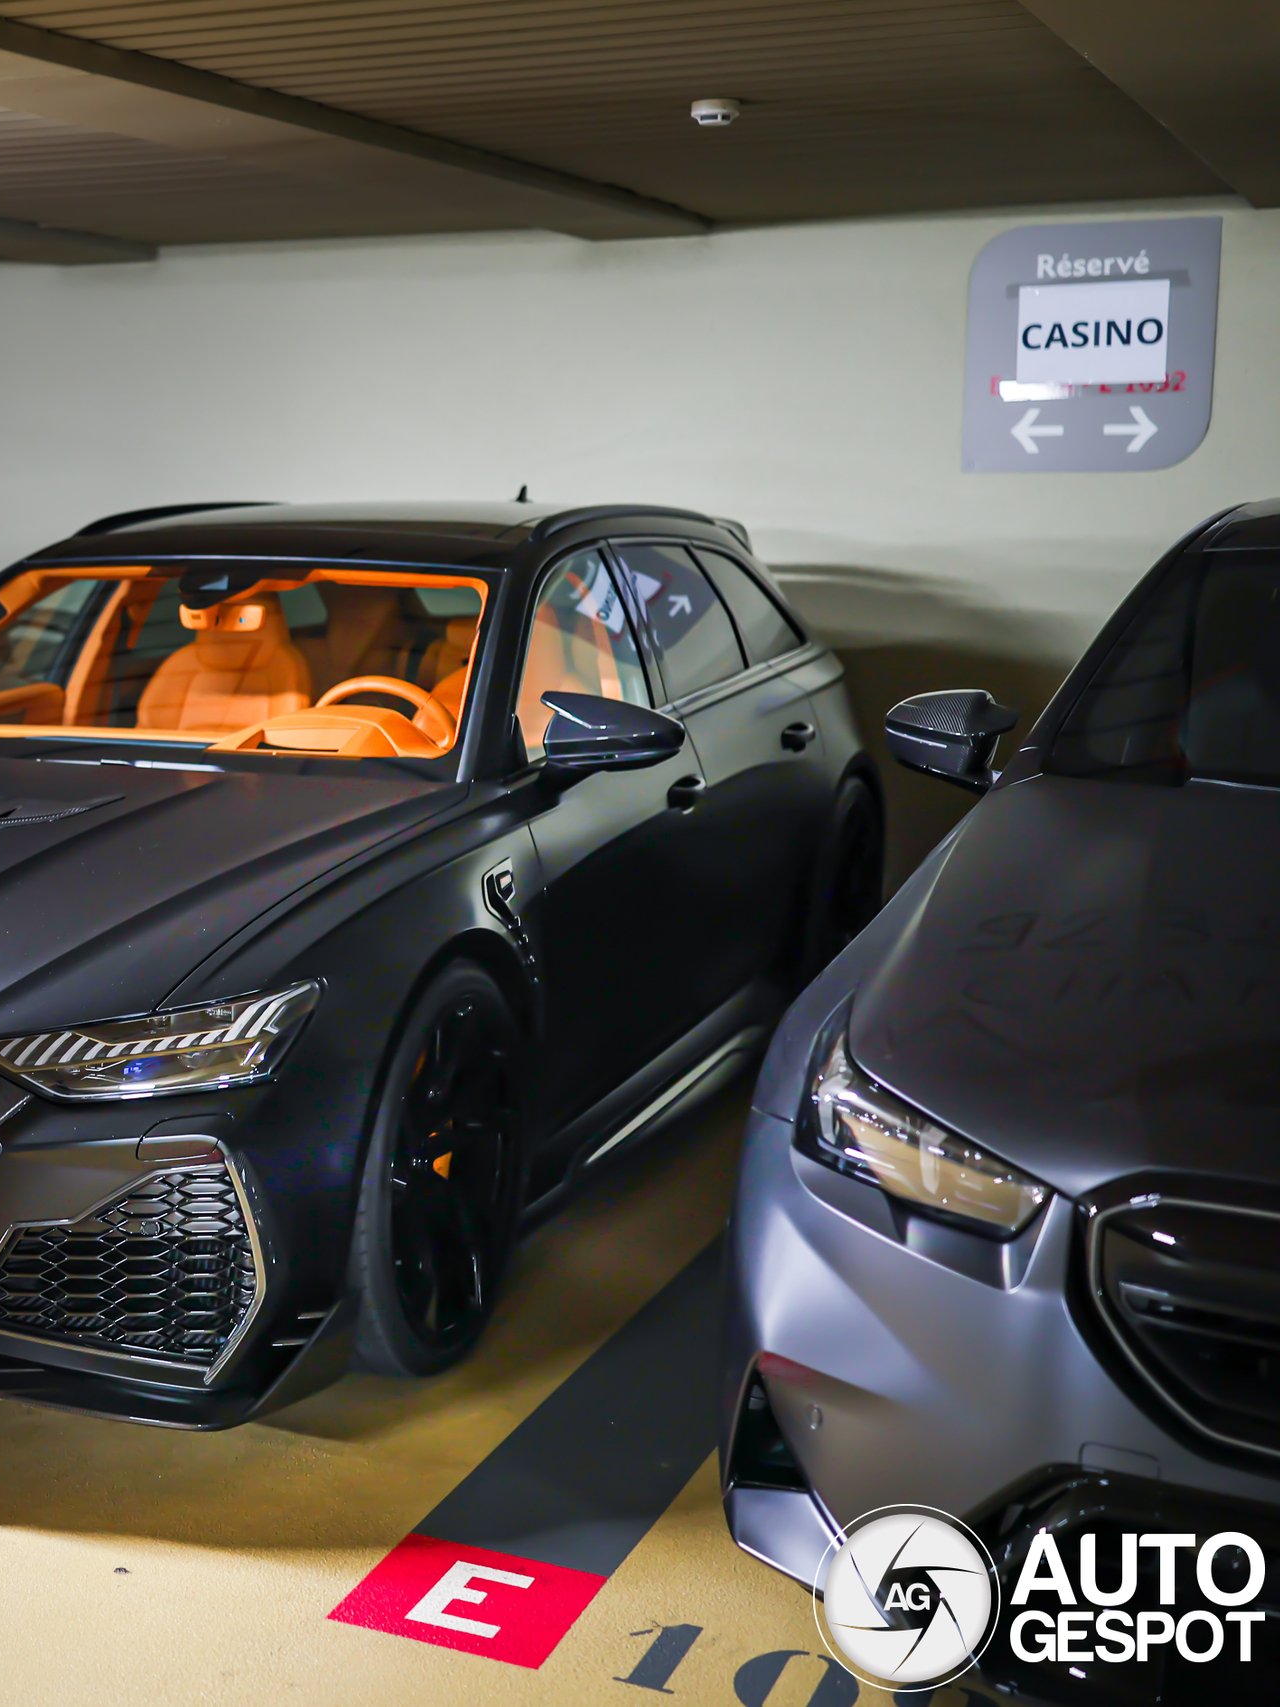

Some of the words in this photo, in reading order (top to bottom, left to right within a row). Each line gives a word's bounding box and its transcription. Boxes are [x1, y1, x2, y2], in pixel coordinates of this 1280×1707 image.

[1036, 249, 1150, 279] Réservé
[1021, 318, 1164, 350] CASINO
[404, 1560, 535, 1639] E
